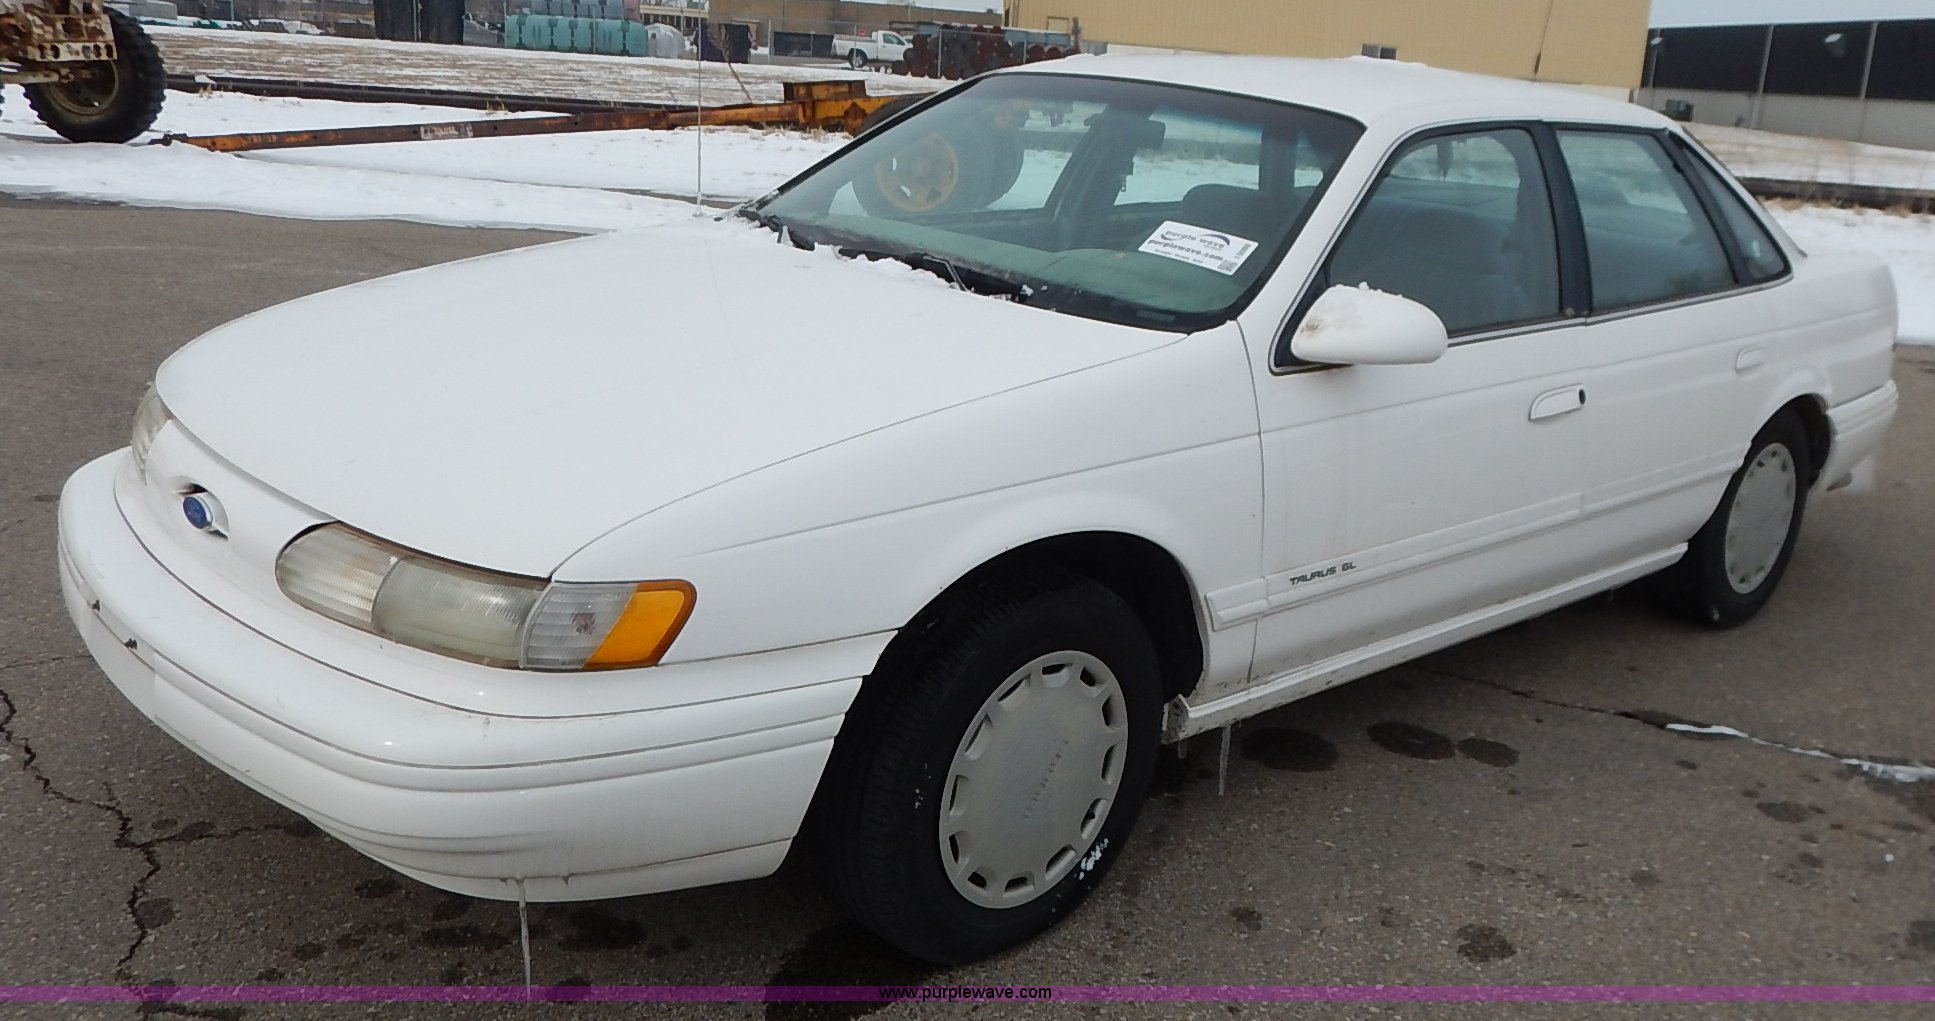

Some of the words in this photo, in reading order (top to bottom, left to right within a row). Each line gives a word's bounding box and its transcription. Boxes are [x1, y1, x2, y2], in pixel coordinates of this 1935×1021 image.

[1148, 239, 1224, 261] purplewave.com
[1165, 231, 1197, 241] purple
[1199, 238, 1225, 249] wave
[1289, 566, 1337, 585] TAURUS
[1341, 562, 1357, 572] GL
